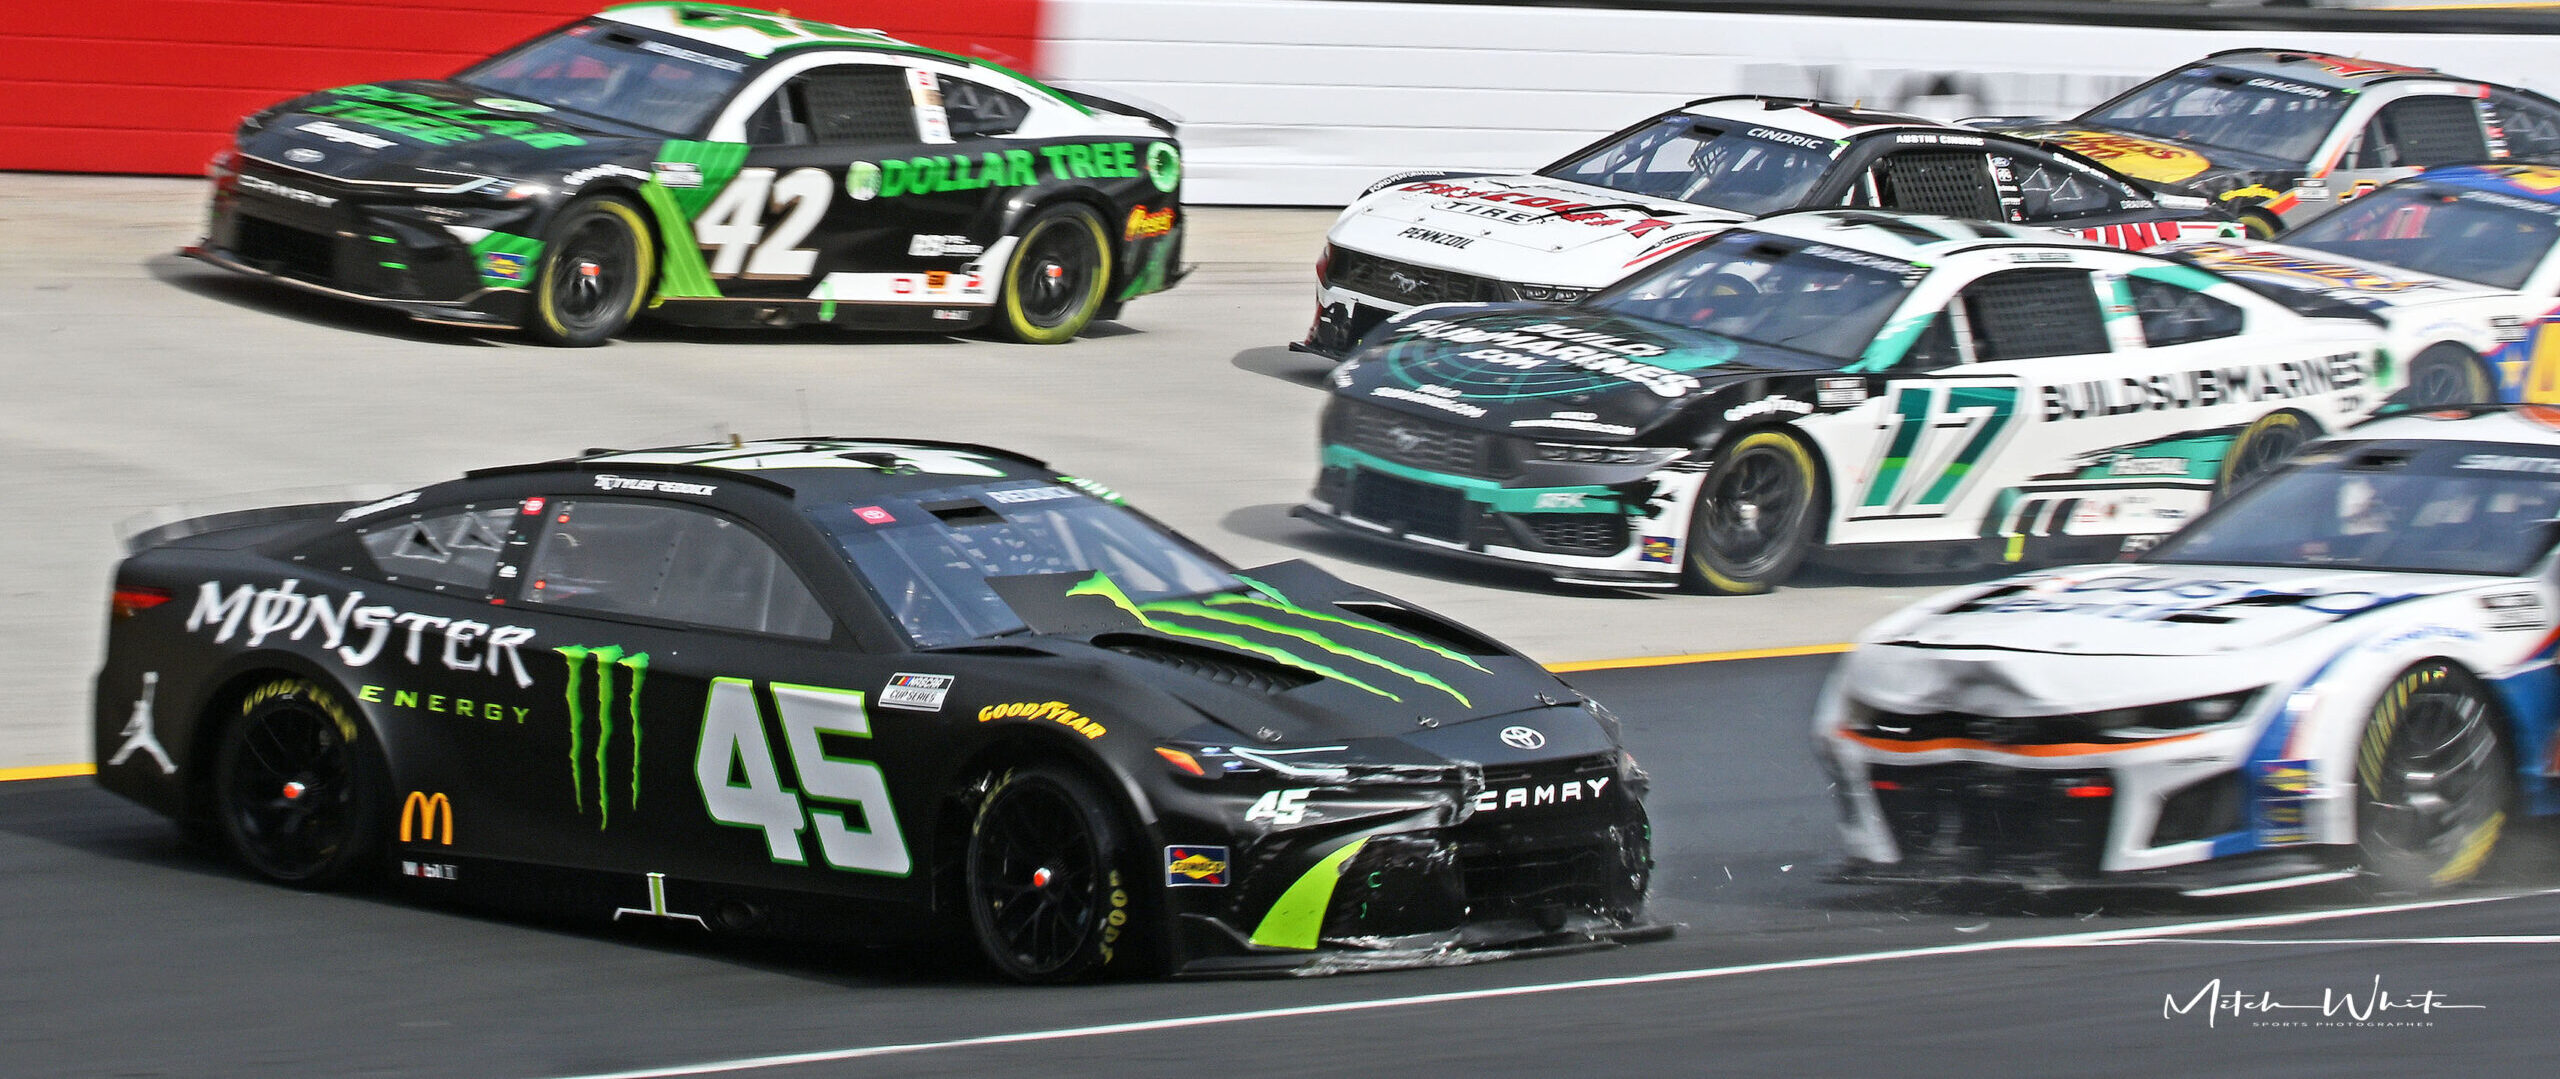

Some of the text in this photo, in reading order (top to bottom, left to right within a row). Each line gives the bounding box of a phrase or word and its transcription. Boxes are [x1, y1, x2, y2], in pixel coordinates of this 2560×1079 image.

[1747, 127, 1825, 150] CINDRIC
[1939, 135, 1985, 146] CINDRIC
[879, 142, 1142, 199] DOLLAR TREE
[694, 167, 834, 280] 42
[1446, 200, 1533, 224] TIRE
[1397, 227, 1475, 250] PENNZOIL
[1395, 319, 1701, 398] SUBMARINES
[1512, 323, 1667, 357] BUILD
[2040, 350, 2367, 424] BUILDSUBMARINES
[1852, 382, 2022, 514] 17
[889, 689, 937, 704] CUP SERIES
[908, 675, 945, 690] NASCAR
[357, 685, 533, 726] ENERGY
[977, 699, 1109, 741] GOODYEAR
[694, 676, 913, 878] 45
[1474, 776, 1610, 812] CAMRY
[1245, 786, 1318, 826] 45
